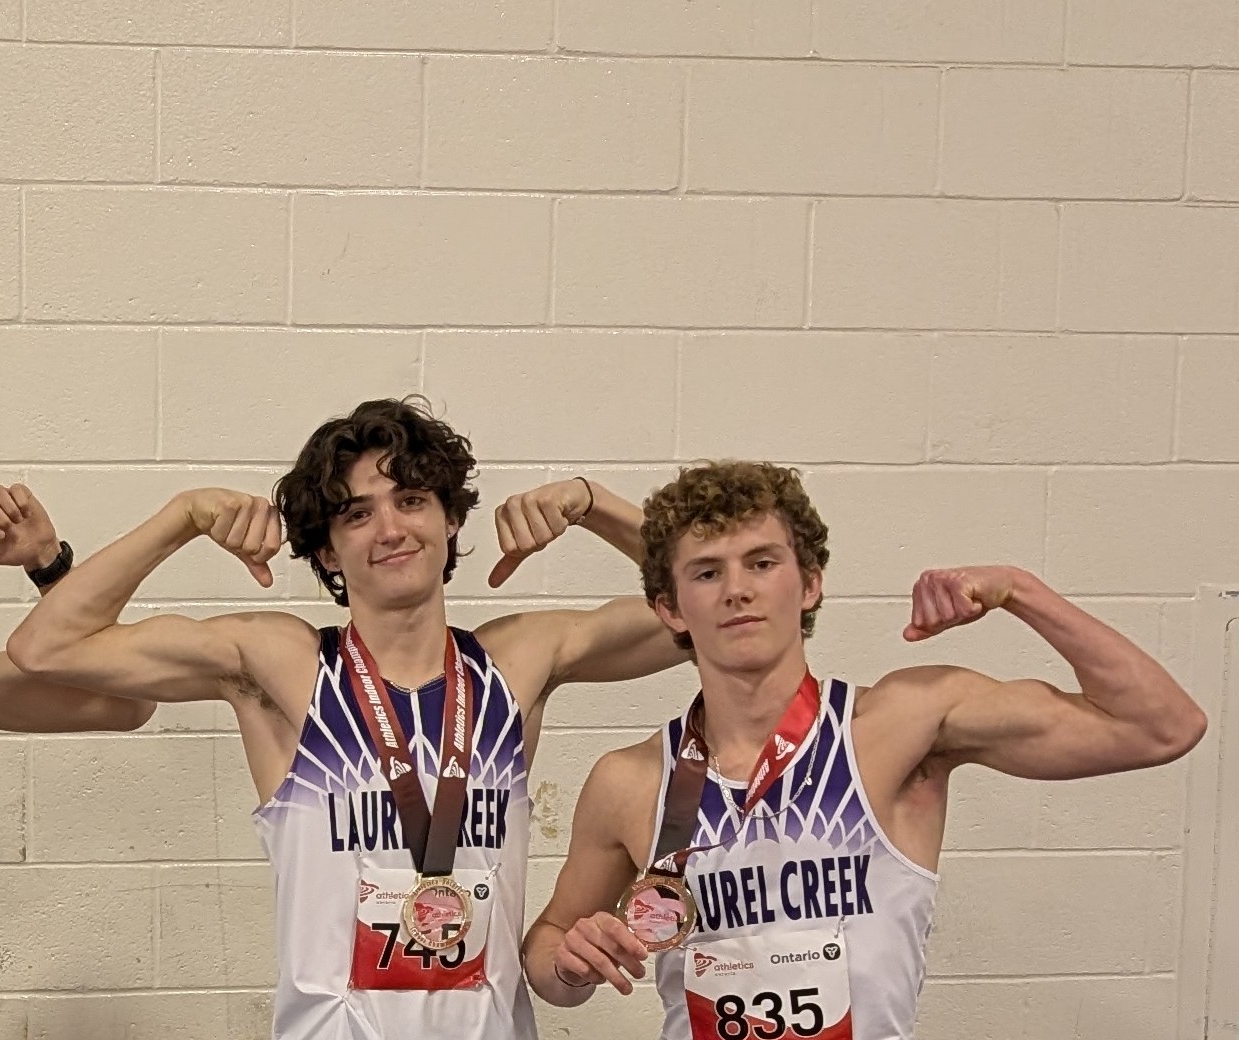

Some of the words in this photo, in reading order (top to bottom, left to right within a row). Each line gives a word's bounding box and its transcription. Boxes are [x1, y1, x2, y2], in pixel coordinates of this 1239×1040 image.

[360, 674, 382, 705] Indoor
[373, 705, 399, 749] Athletics
[454, 706, 465, 753] Athletics
[328, 790, 410, 852] LAUR
[696, 865, 775, 933] UREL
[780, 854, 874, 921] CREEK
[770, 950, 821, 965] Ontario
